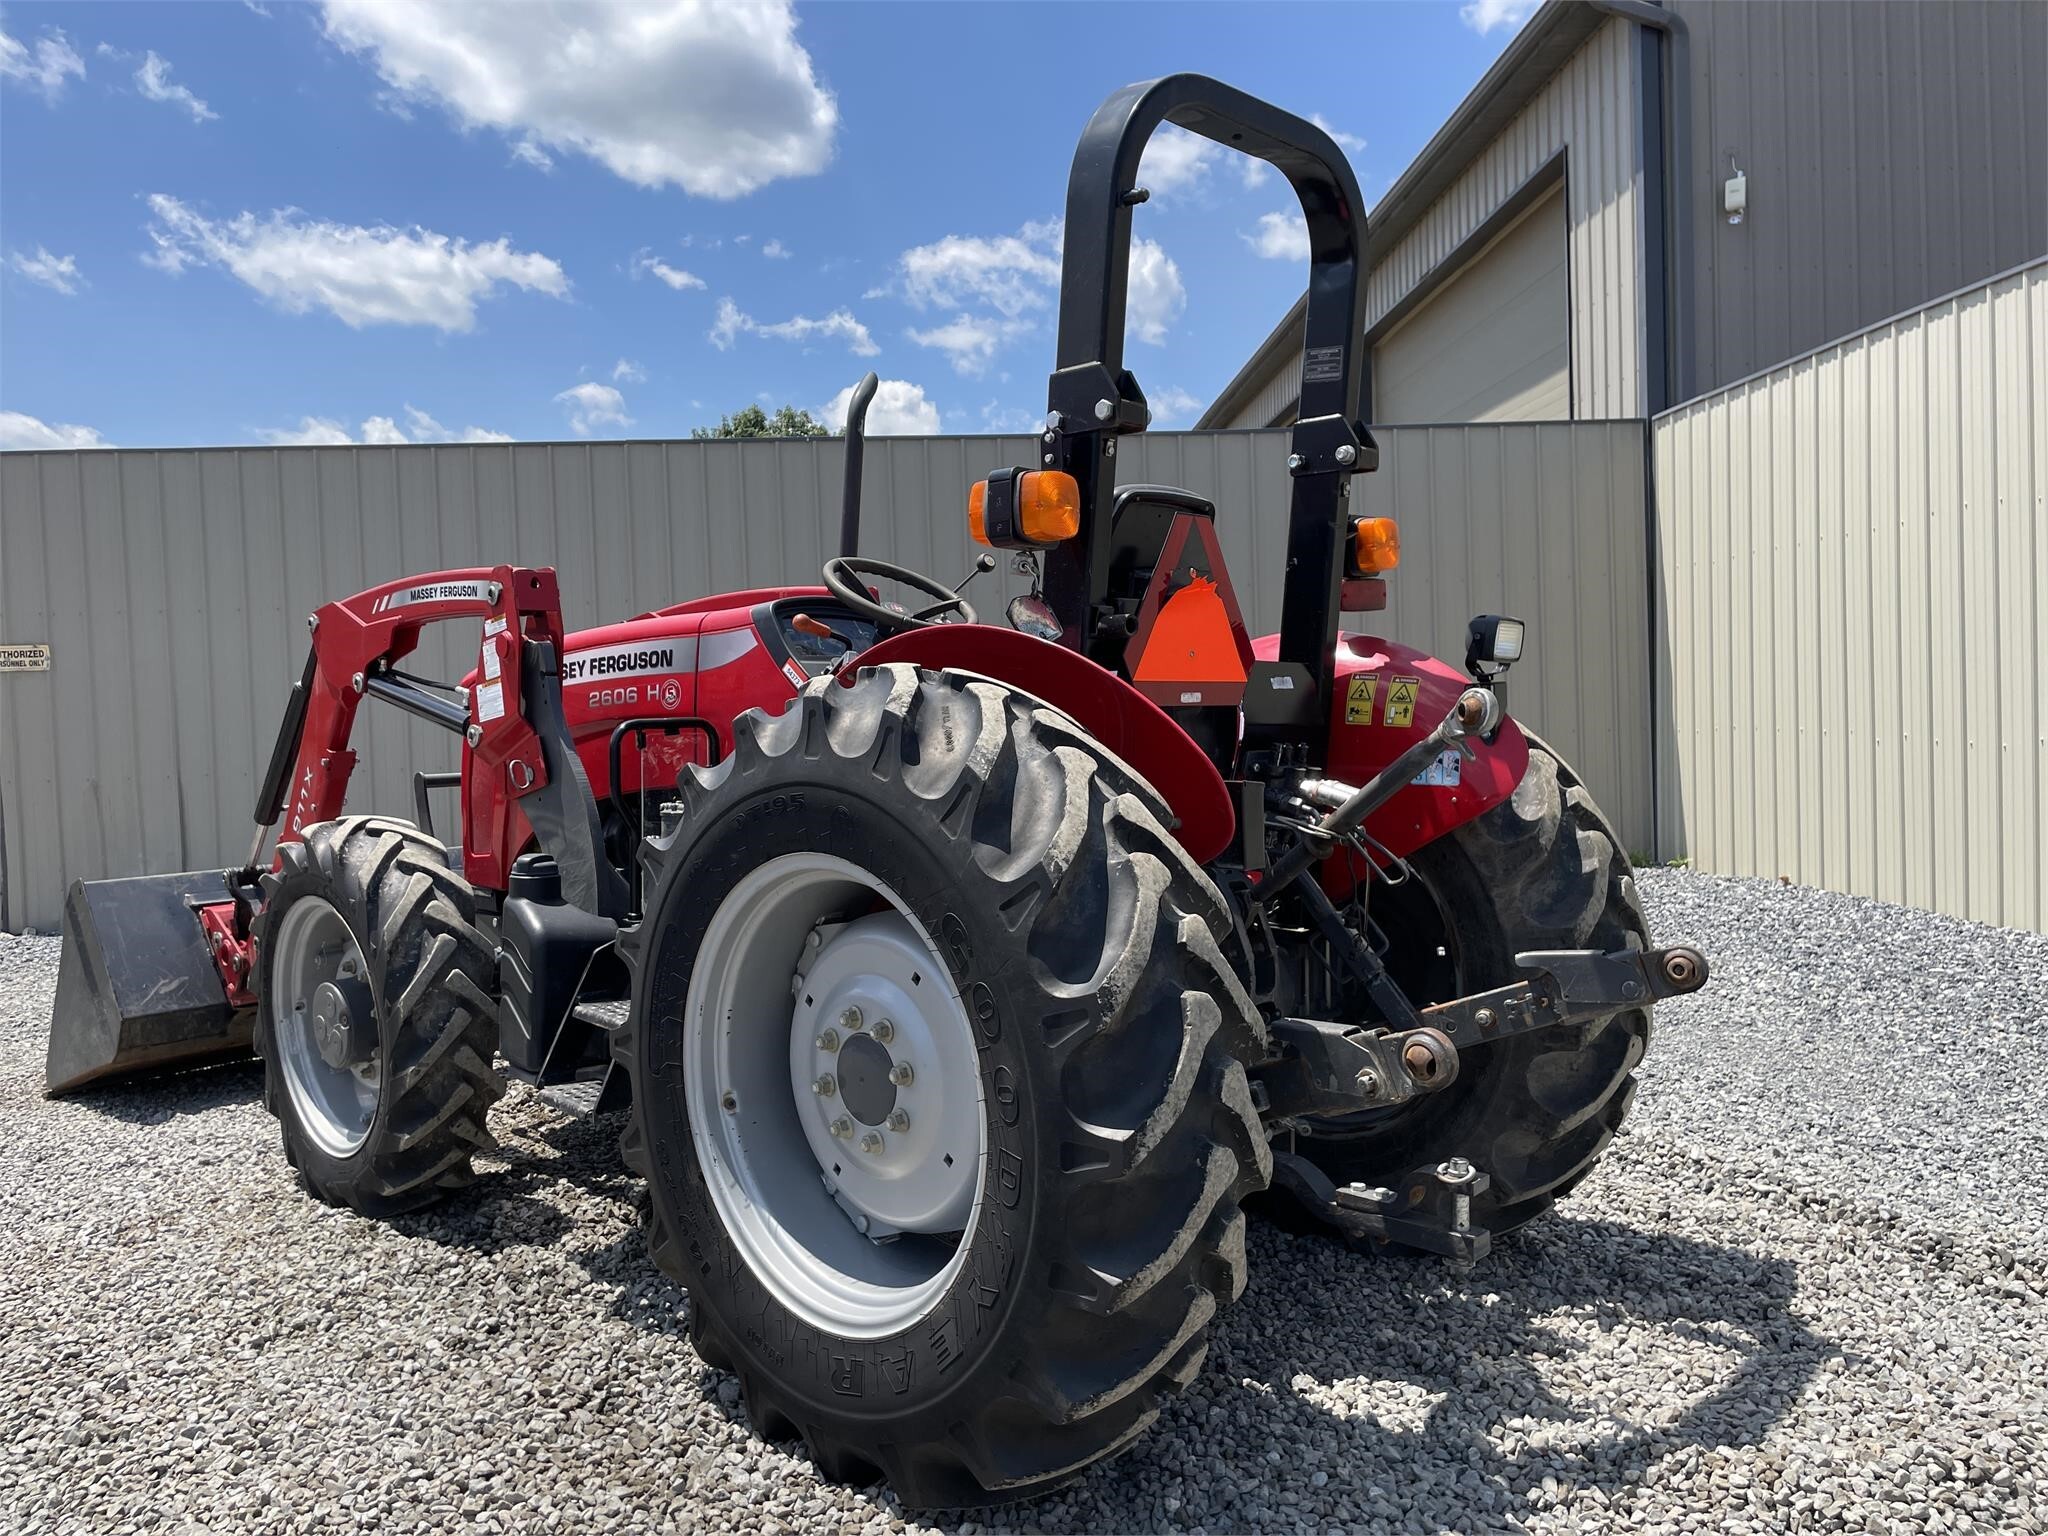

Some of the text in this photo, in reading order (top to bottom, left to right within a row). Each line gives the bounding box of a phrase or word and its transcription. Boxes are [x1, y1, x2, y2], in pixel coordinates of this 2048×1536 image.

[410, 585, 478, 601] MASSEY FERGUSON
[0, 650, 44, 658] THORIZED
[589, 649, 674, 676] FERGUSON
[588, 686, 638, 708] 2606
[647, 683, 660, 702] H
[831, 911, 1023, 1398] GOODYEAR
